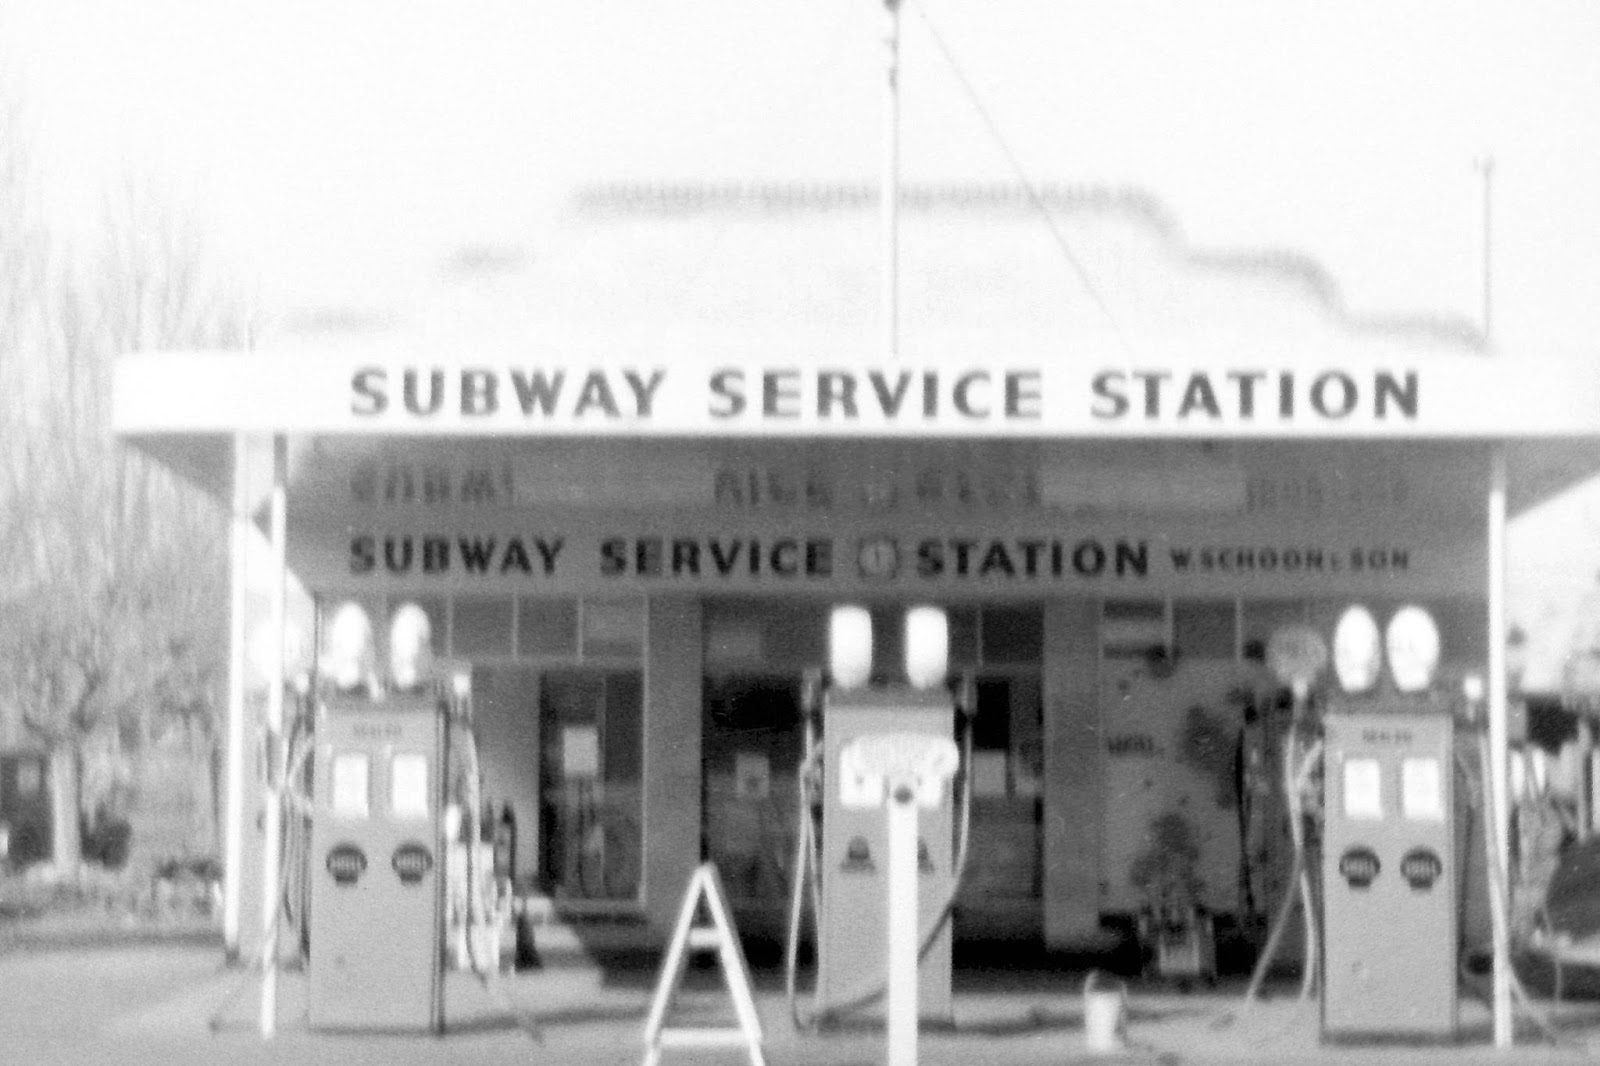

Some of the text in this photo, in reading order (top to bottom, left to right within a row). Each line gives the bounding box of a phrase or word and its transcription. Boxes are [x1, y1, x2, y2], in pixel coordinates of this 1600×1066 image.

[350, 368, 1420, 420] SUBWAY SERVICE STATION
[350, 536, 1149, 579] SUBWAY SERVICE STATION
